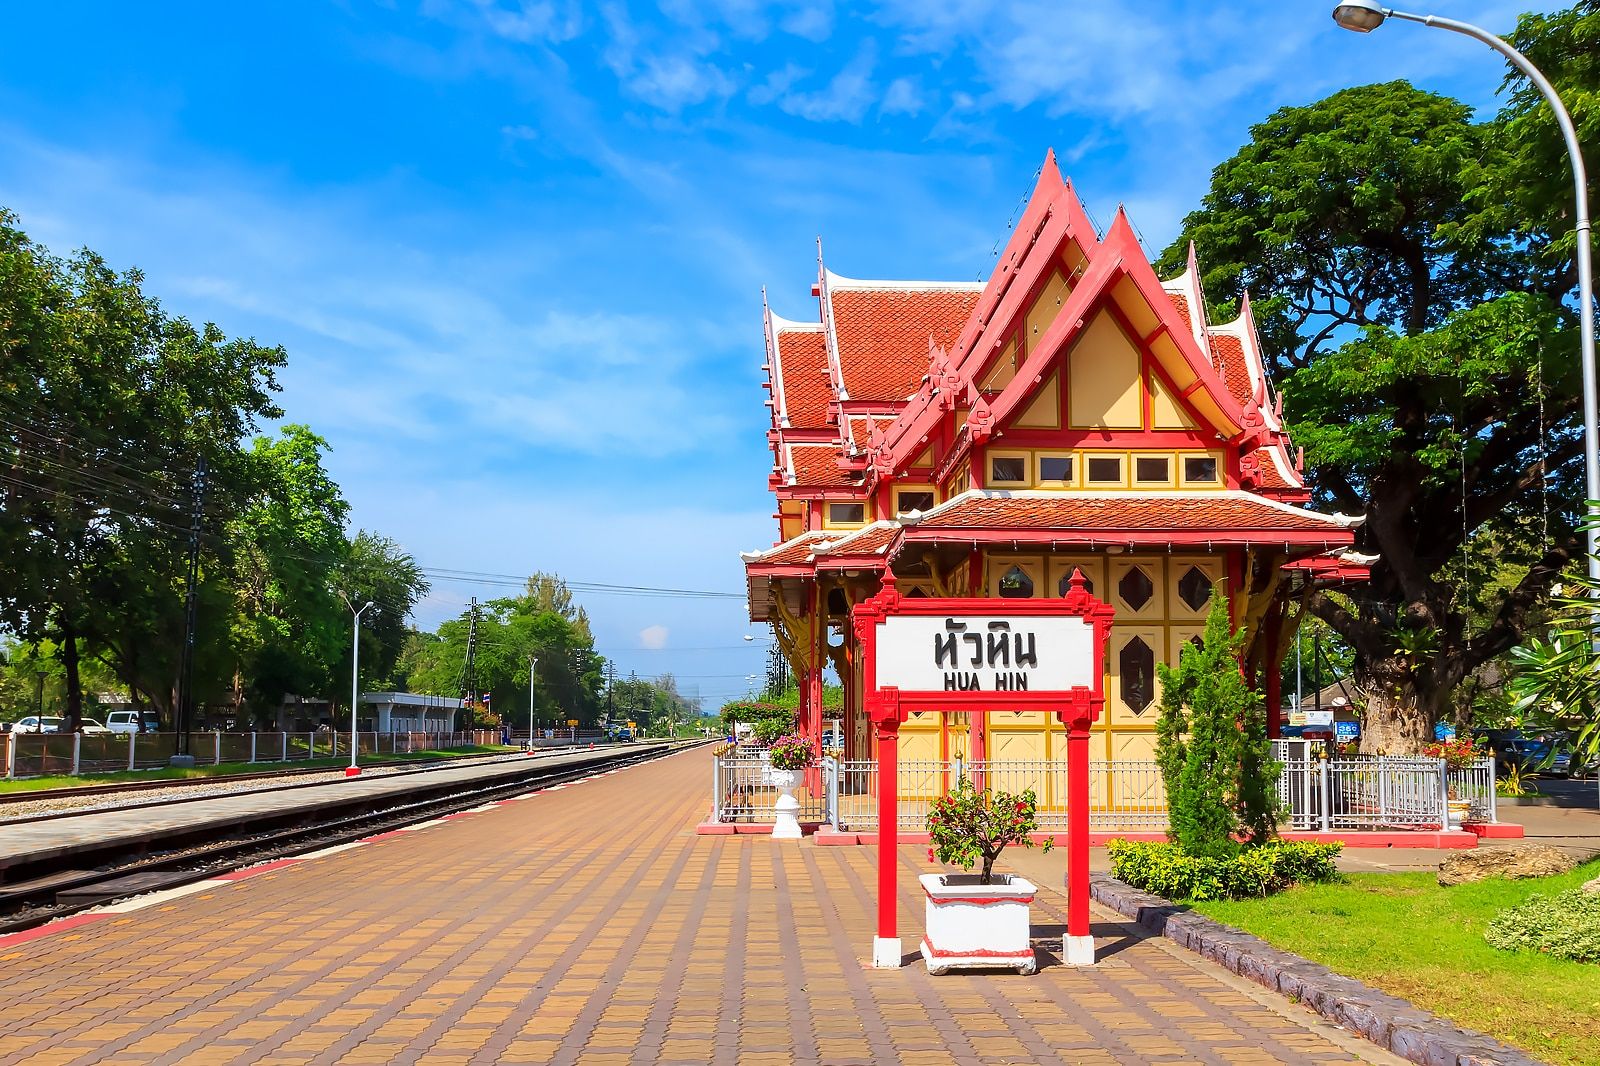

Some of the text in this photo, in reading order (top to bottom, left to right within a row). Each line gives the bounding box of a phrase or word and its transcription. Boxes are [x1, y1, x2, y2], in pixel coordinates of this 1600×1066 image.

[934, 617, 1037, 668] หัวหิน
[944, 671, 1028, 691] HUA HIN
